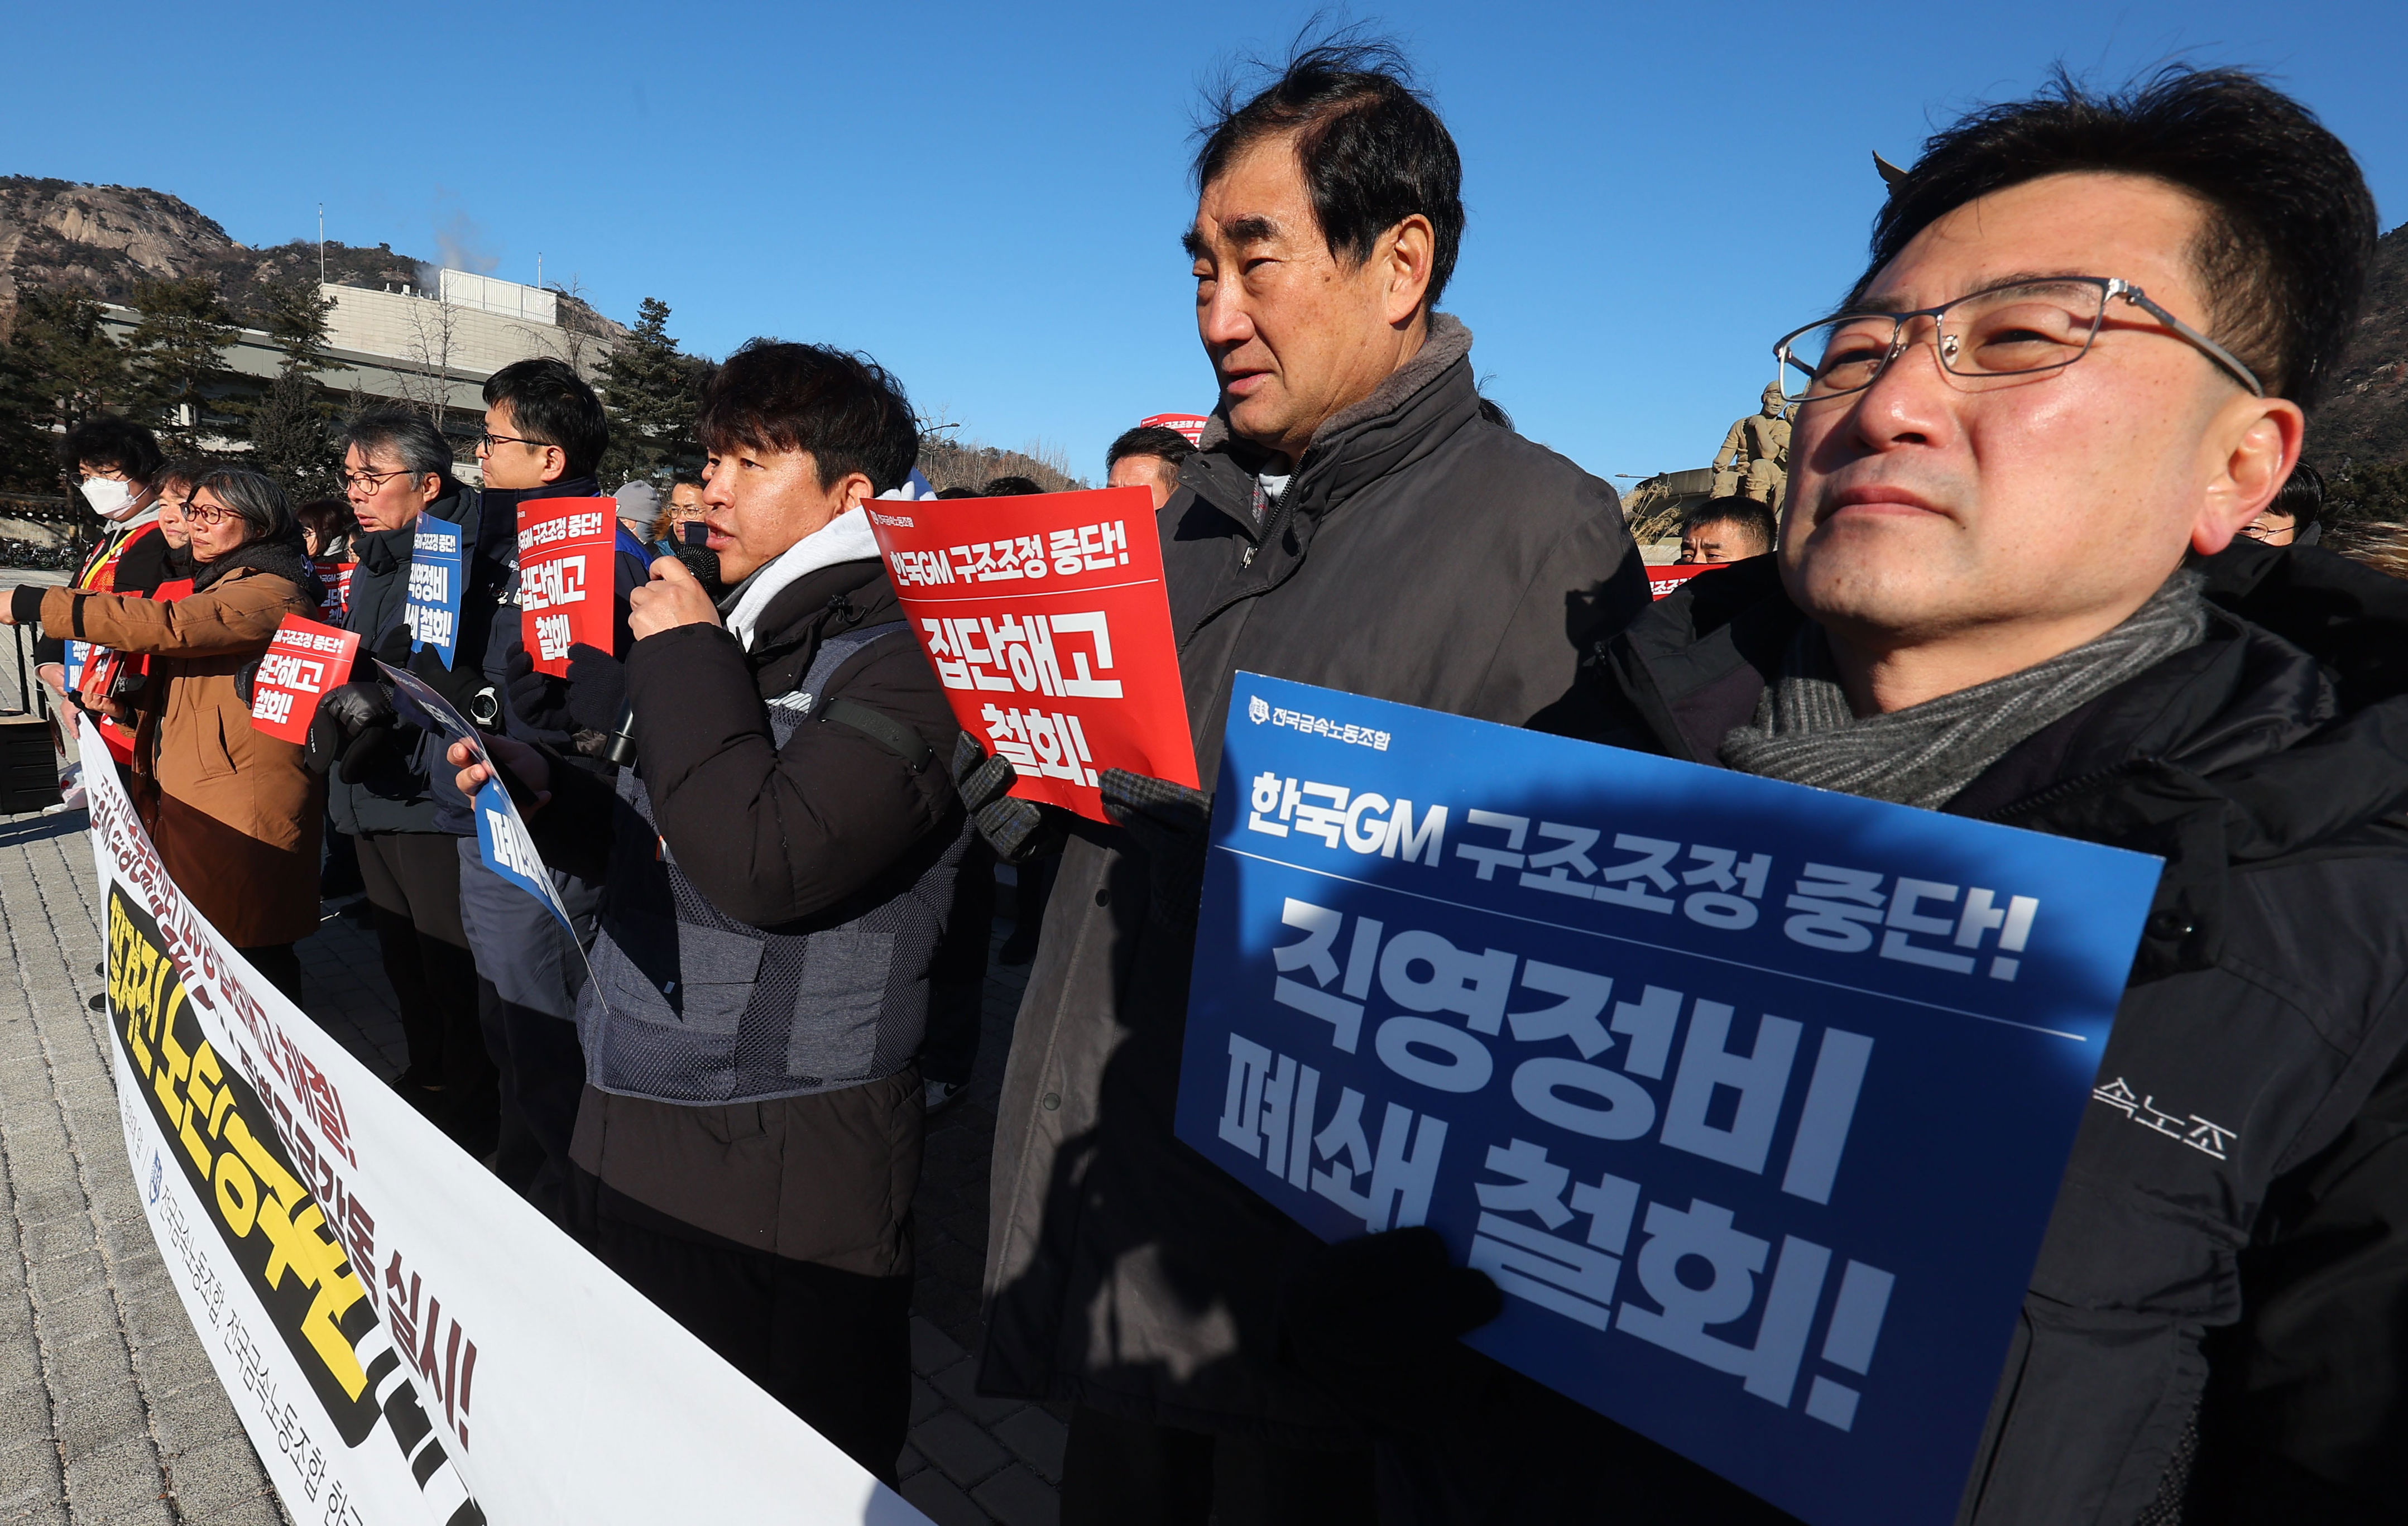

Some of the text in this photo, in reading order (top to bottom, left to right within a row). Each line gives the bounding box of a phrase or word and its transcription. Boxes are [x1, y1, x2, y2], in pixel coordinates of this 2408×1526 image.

[422, 532, 438, 551] 구조조정
[439, 534, 455, 553] 중단!
[533, 516, 567, 545] 구조조정
[568, 512, 602, 539] 중단!
[877, 514, 914, 528] 전국금속노동조합
[890, 520, 1129, 587] 한국GM 구조조정 중단!
[408, 563, 448, 603] 직영정비
[521, 555, 586, 612] 집단해고
[282, 630, 314, 649] 구조조정
[313, 635, 346, 654] 중단!
[419, 606, 453, 647] 철회!
[921, 611, 1124, 699] 집단해고
[255, 654, 325, 694] 집단해고
[252, 687, 294, 724] 철회!
[1273, 707, 1391, 751] 전국금속노동조합
[981, 703, 1099, 788] 철회!
[1248, 770, 2040, 983] 한국GM 구조조정 중단!
[1272, 897, 1874, 1206] 직영정비
[276, 1023, 358, 1172] 해결!
[1218, 1031, 1896, 1434] 폐쇄 철회!
[160, 1184, 224, 1332] 전국금속노동조합,
[224, 1308, 327, 1504] 전국금속노동조합
[386, 1248, 477, 1455] 실시!
